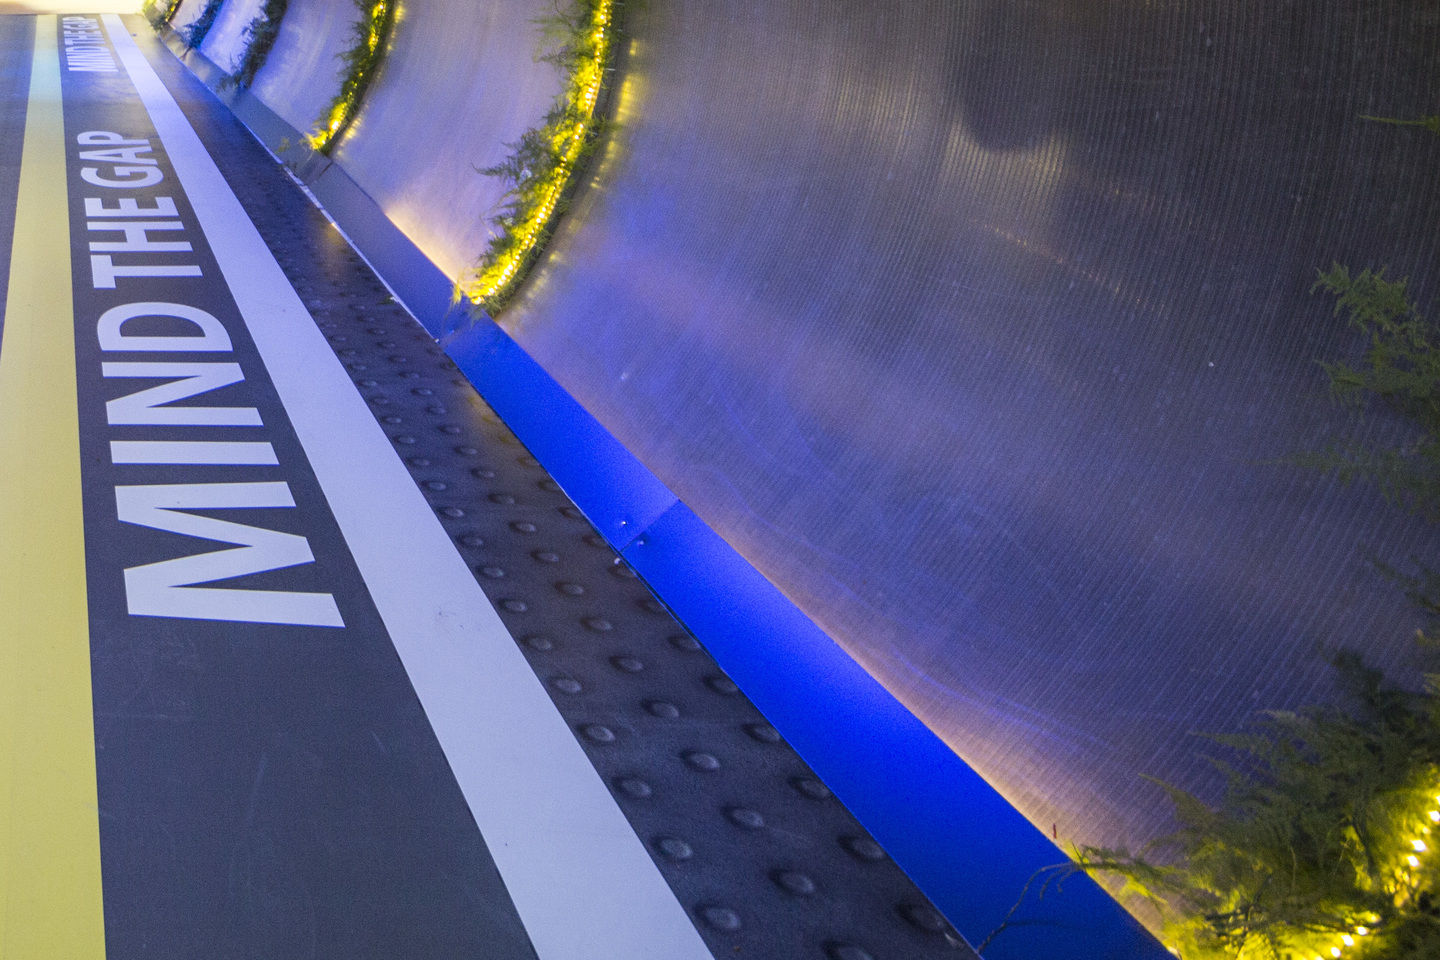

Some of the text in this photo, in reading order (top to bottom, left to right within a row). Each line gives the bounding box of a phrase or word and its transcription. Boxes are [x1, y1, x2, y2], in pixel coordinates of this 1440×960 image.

[62, 16, 119, 72] MIND THE GAP
[77, 130, 345, 627] MIND THE GAP
